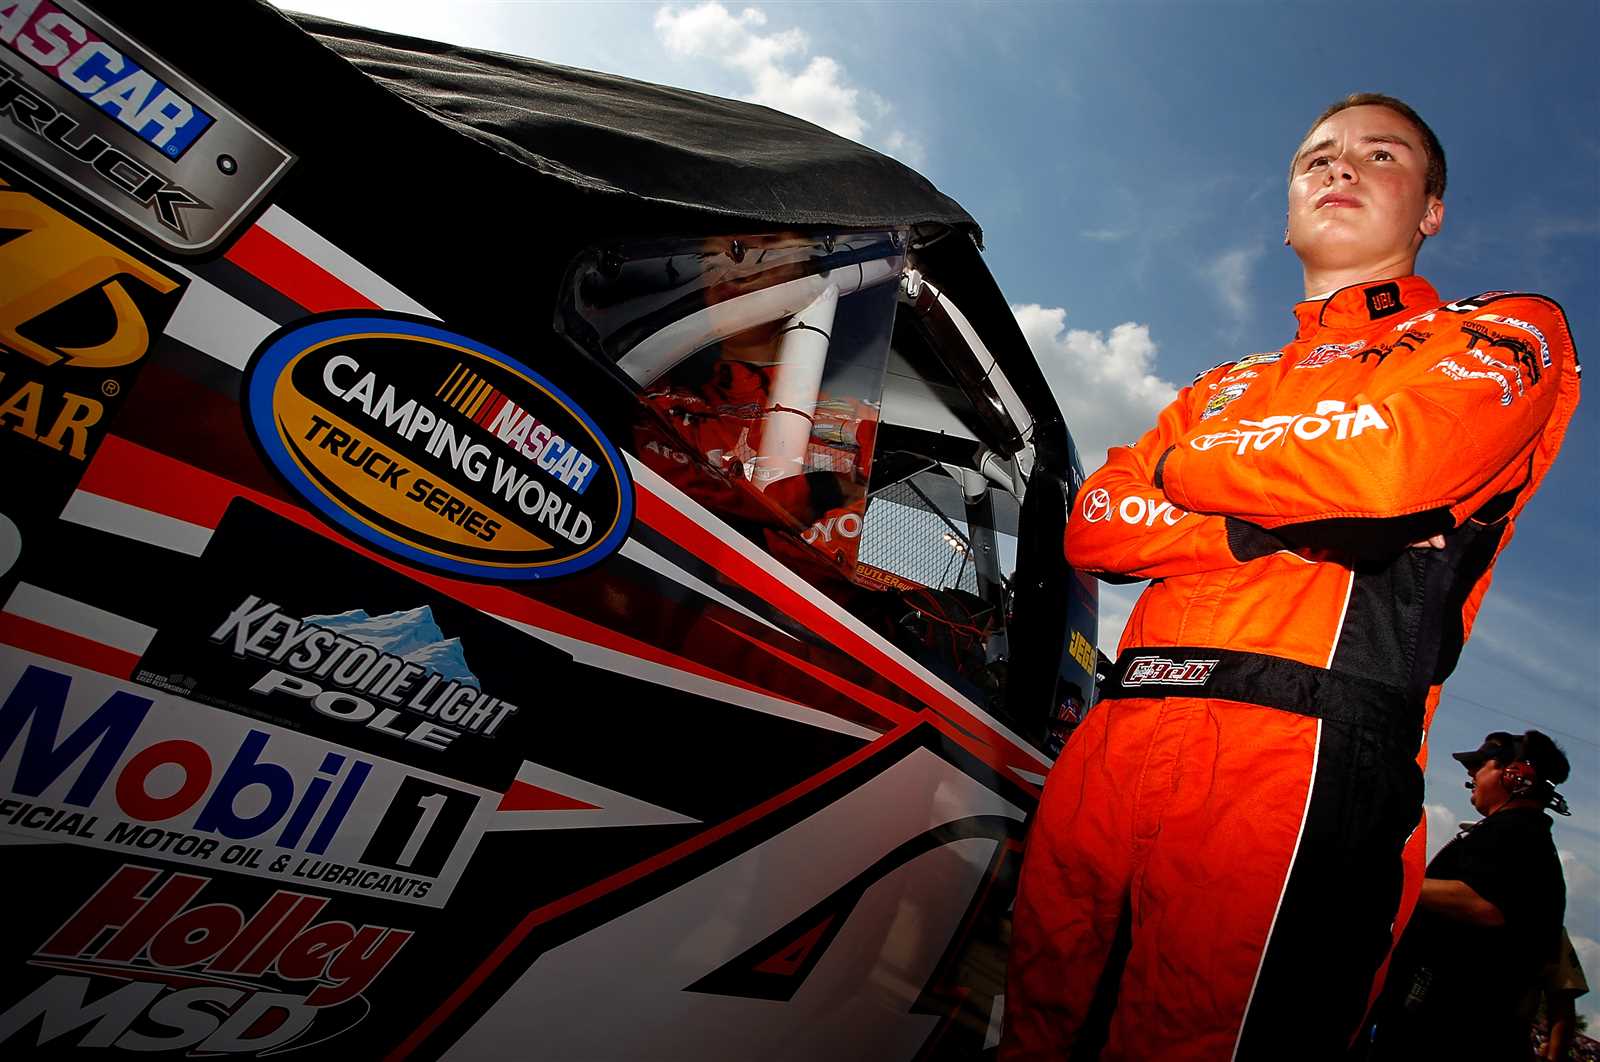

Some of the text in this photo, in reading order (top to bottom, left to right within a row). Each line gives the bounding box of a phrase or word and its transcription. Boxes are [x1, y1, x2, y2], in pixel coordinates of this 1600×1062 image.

[0, 66, 201, 232] RUCK
[1372, 292, 1395, 310] JBL
[304, 414, 503, 543] TRUCK SERIES
[322, 355, 594, 545] CAMPING WORLD
[488, 399, 594, 491] NASCAR
[857, 565, 900, 586] BUTLER
[210, 595, 518, 738] KEYSTONE LIGHT
[249, 669, 461, 751] POLE
[0, 665, 437, 866] Mobil 1
[0, 799, 433, 899] FICIAL MOTOR OIL & LUBRICANTS
[32, 864, 416, 1009] Holley
[0, 975, 318, 1052] MSD
